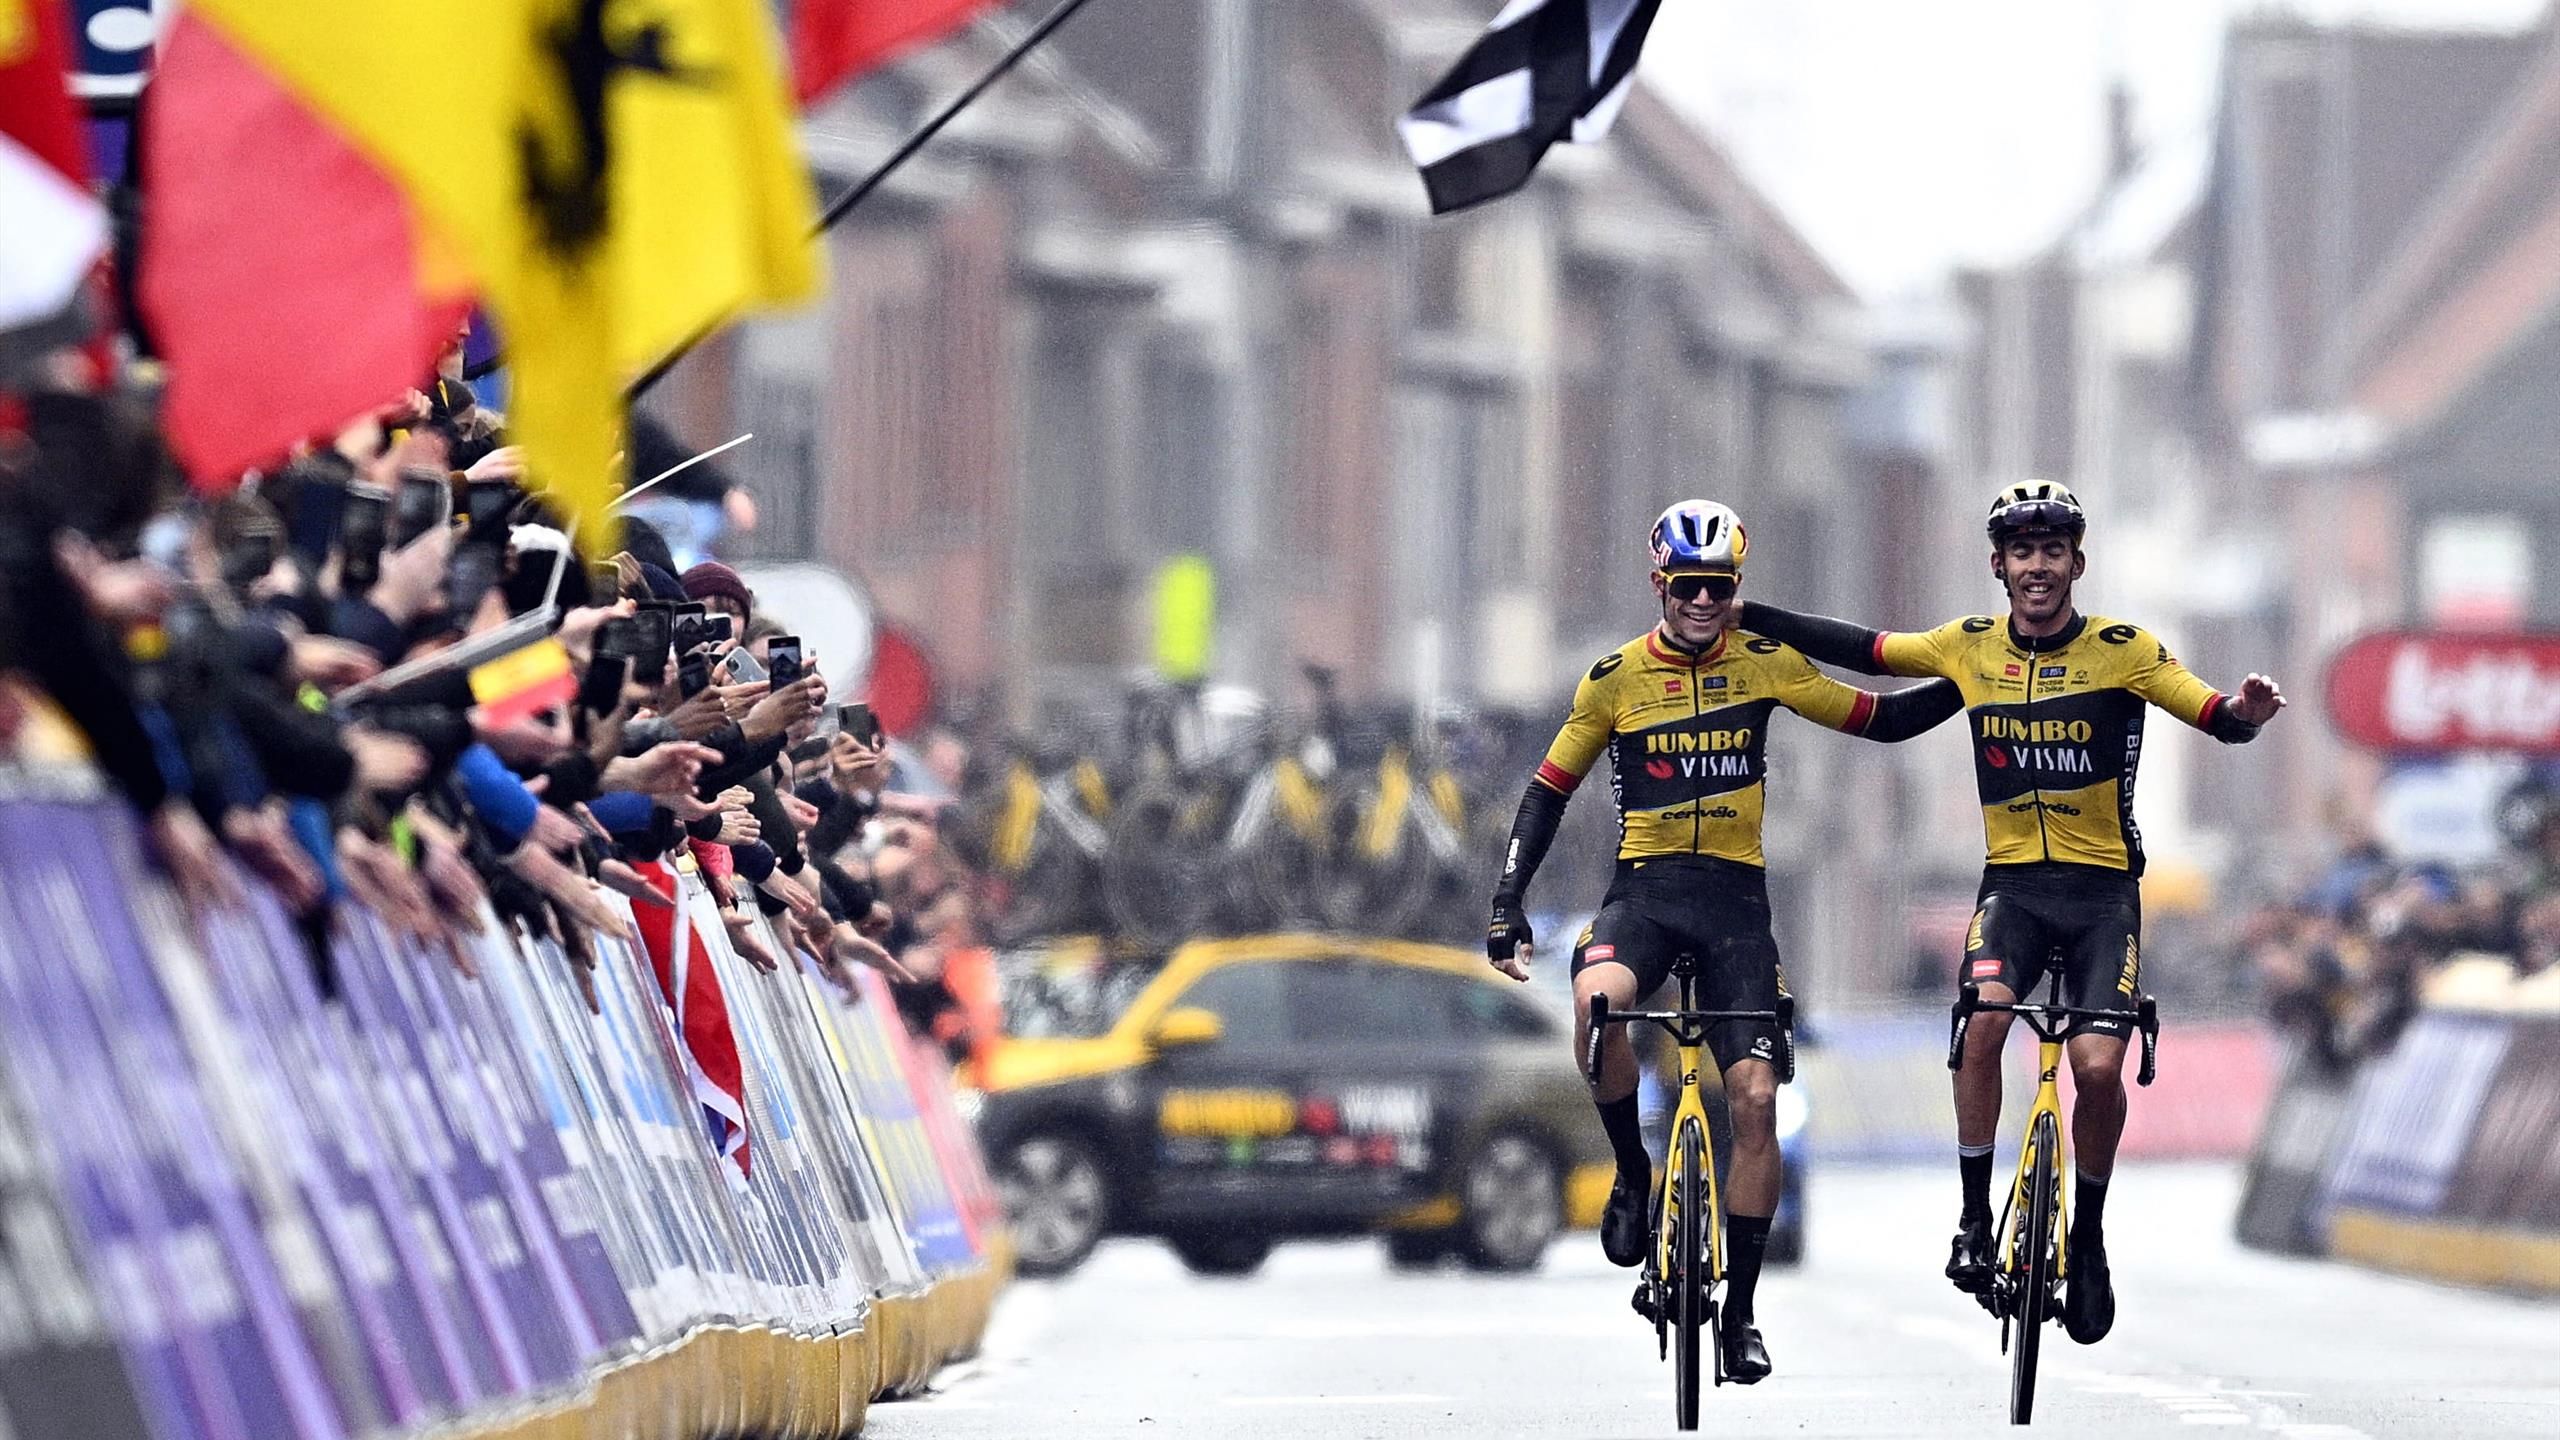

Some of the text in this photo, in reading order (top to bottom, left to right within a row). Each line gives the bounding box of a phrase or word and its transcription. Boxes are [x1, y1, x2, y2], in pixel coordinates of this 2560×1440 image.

[1645, 728, 1752, 754] JUMBO
[1981, 715, 2092, 743] JUMBO
[1680, 755, 1750, 778] VISMA
[2012, 746, 2093, 773] VISMA
[2117, 933, 2138, 999] JUMBO
[2092, 1020, 2118, 1029] AGU
